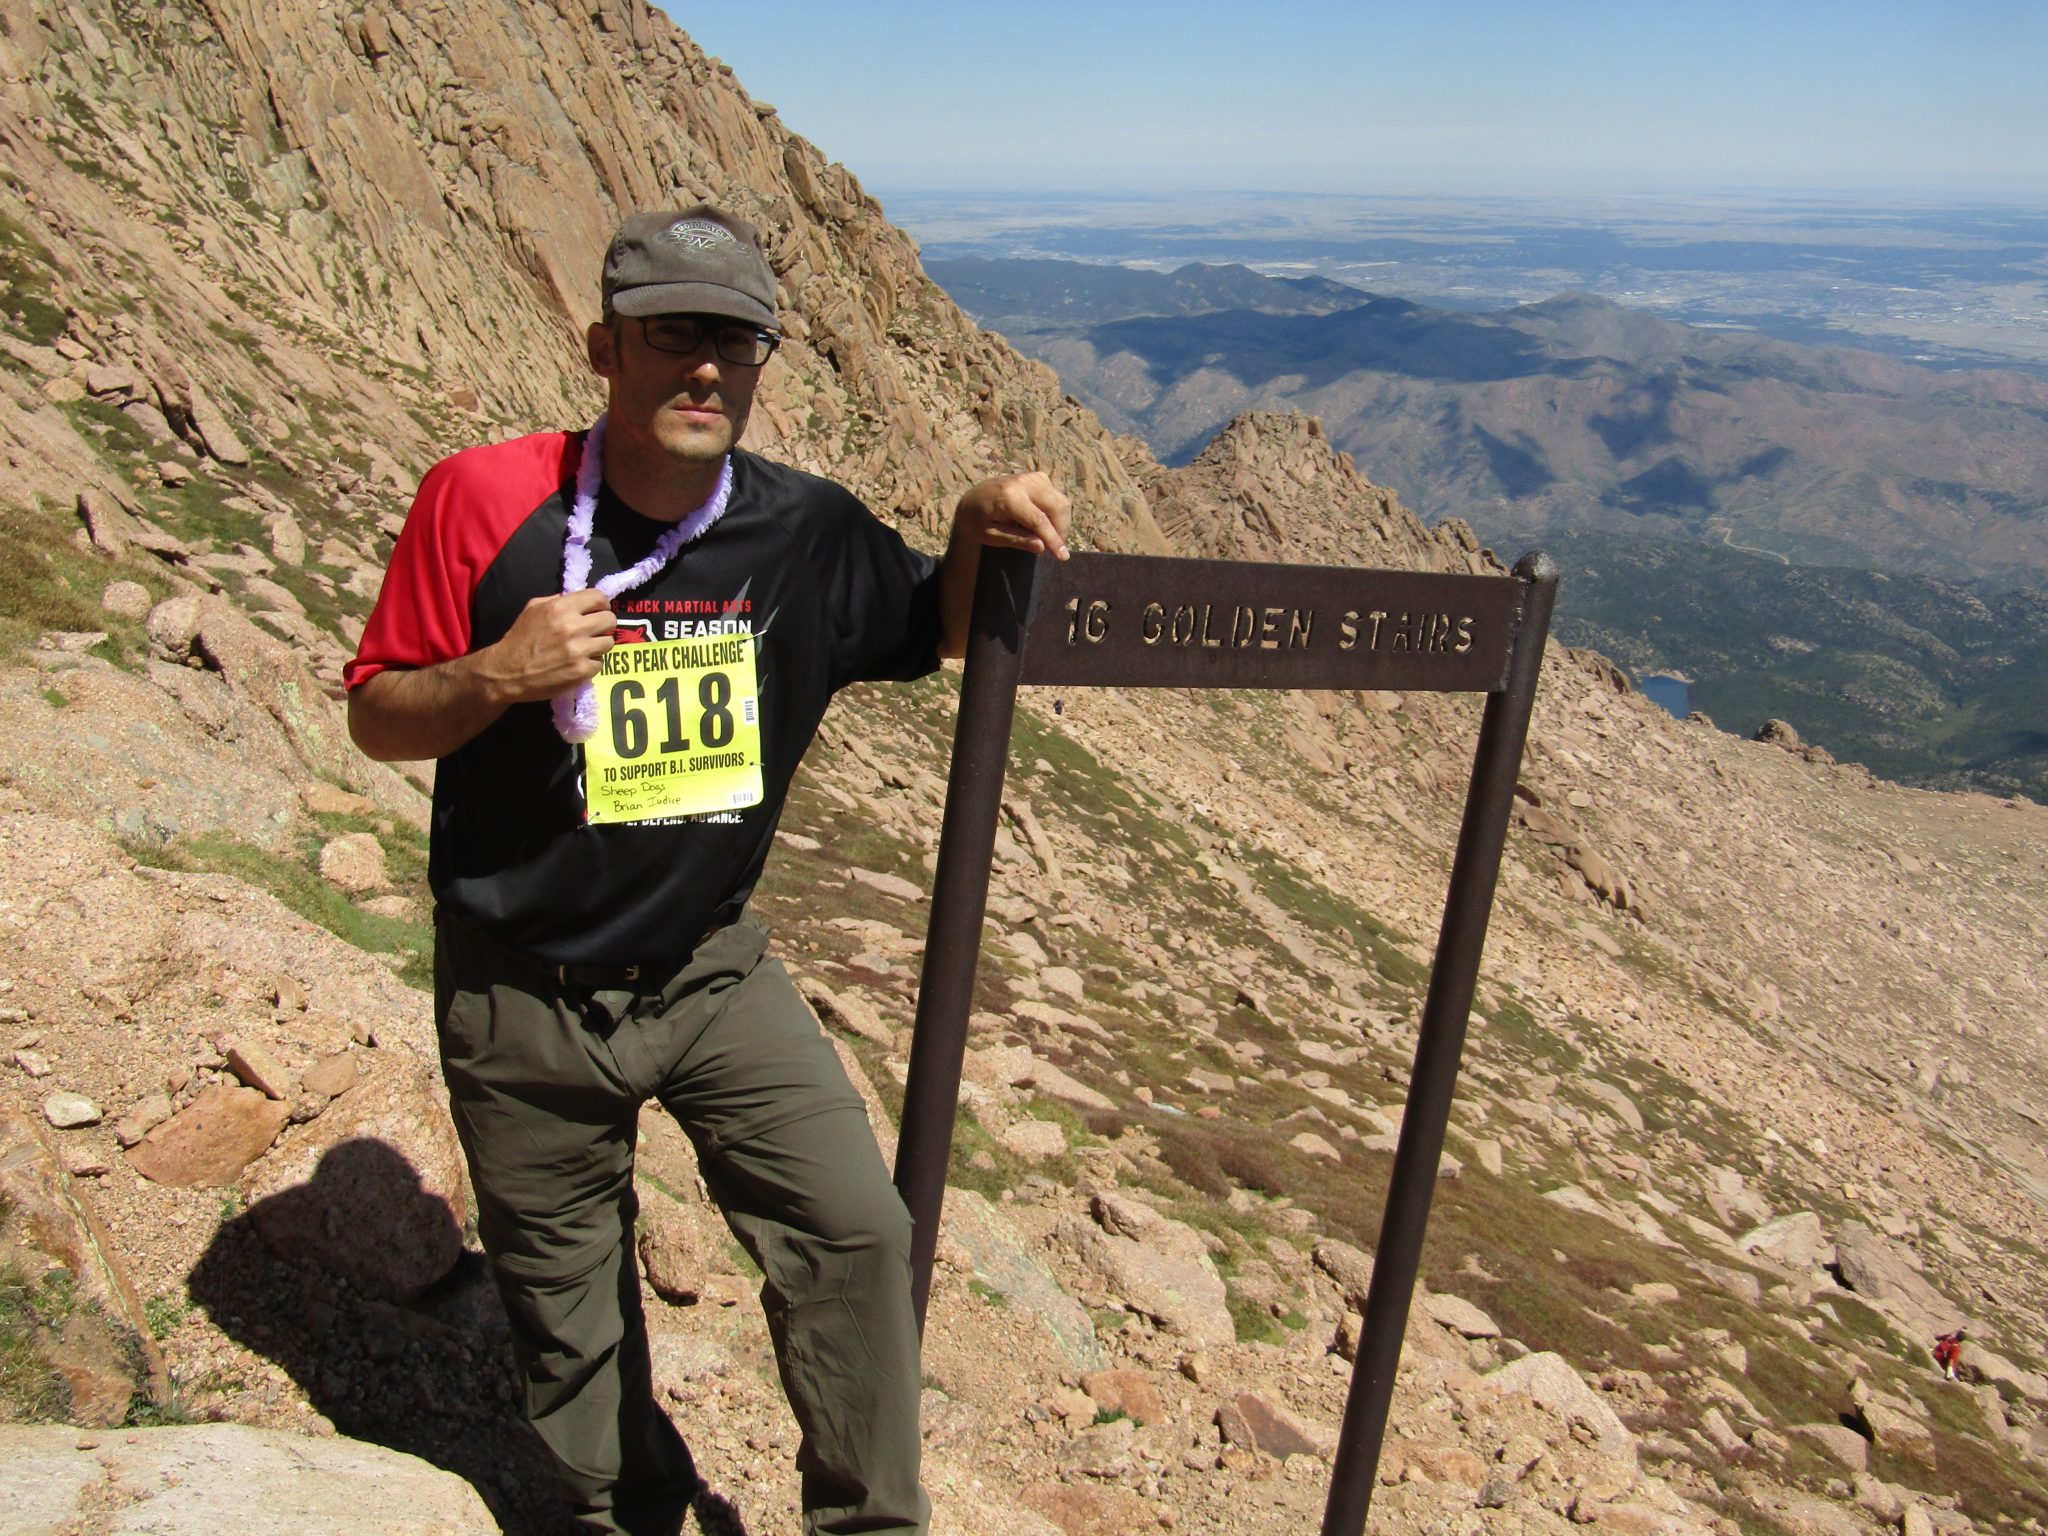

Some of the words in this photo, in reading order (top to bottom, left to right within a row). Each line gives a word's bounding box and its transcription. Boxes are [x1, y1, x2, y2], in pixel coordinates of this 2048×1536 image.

[611, 600, 660, 613] R-ROCK
[664, 600, 718, 613] MARTIAL
[722, 600, 751, 613] ARTS
[664, 620, 751, 639] SEASON
[1064, 597, 1111, 646] 16
[1142, 602, 1315, 650] GOLDEN
[1338, 610, 1476, 655] STAIRS
[600, 651, 630, 676] IKES
[633, 648, 669, 673] PEAK
[672, 640, 744, 670] CHALLENGE
[609, 672, 735, 759] 618
[604, 767, 617, 782] TO
[620, 761, 666, 781] SUPPORT
[670, 760, 686, 774] B.I.
[689, 752, 745, 772] SURVIVORS
[601, 785, 637, 798] Sheep
[641, 781, 666, 795] Dogs
[613, 800, 643, 813] Brian
